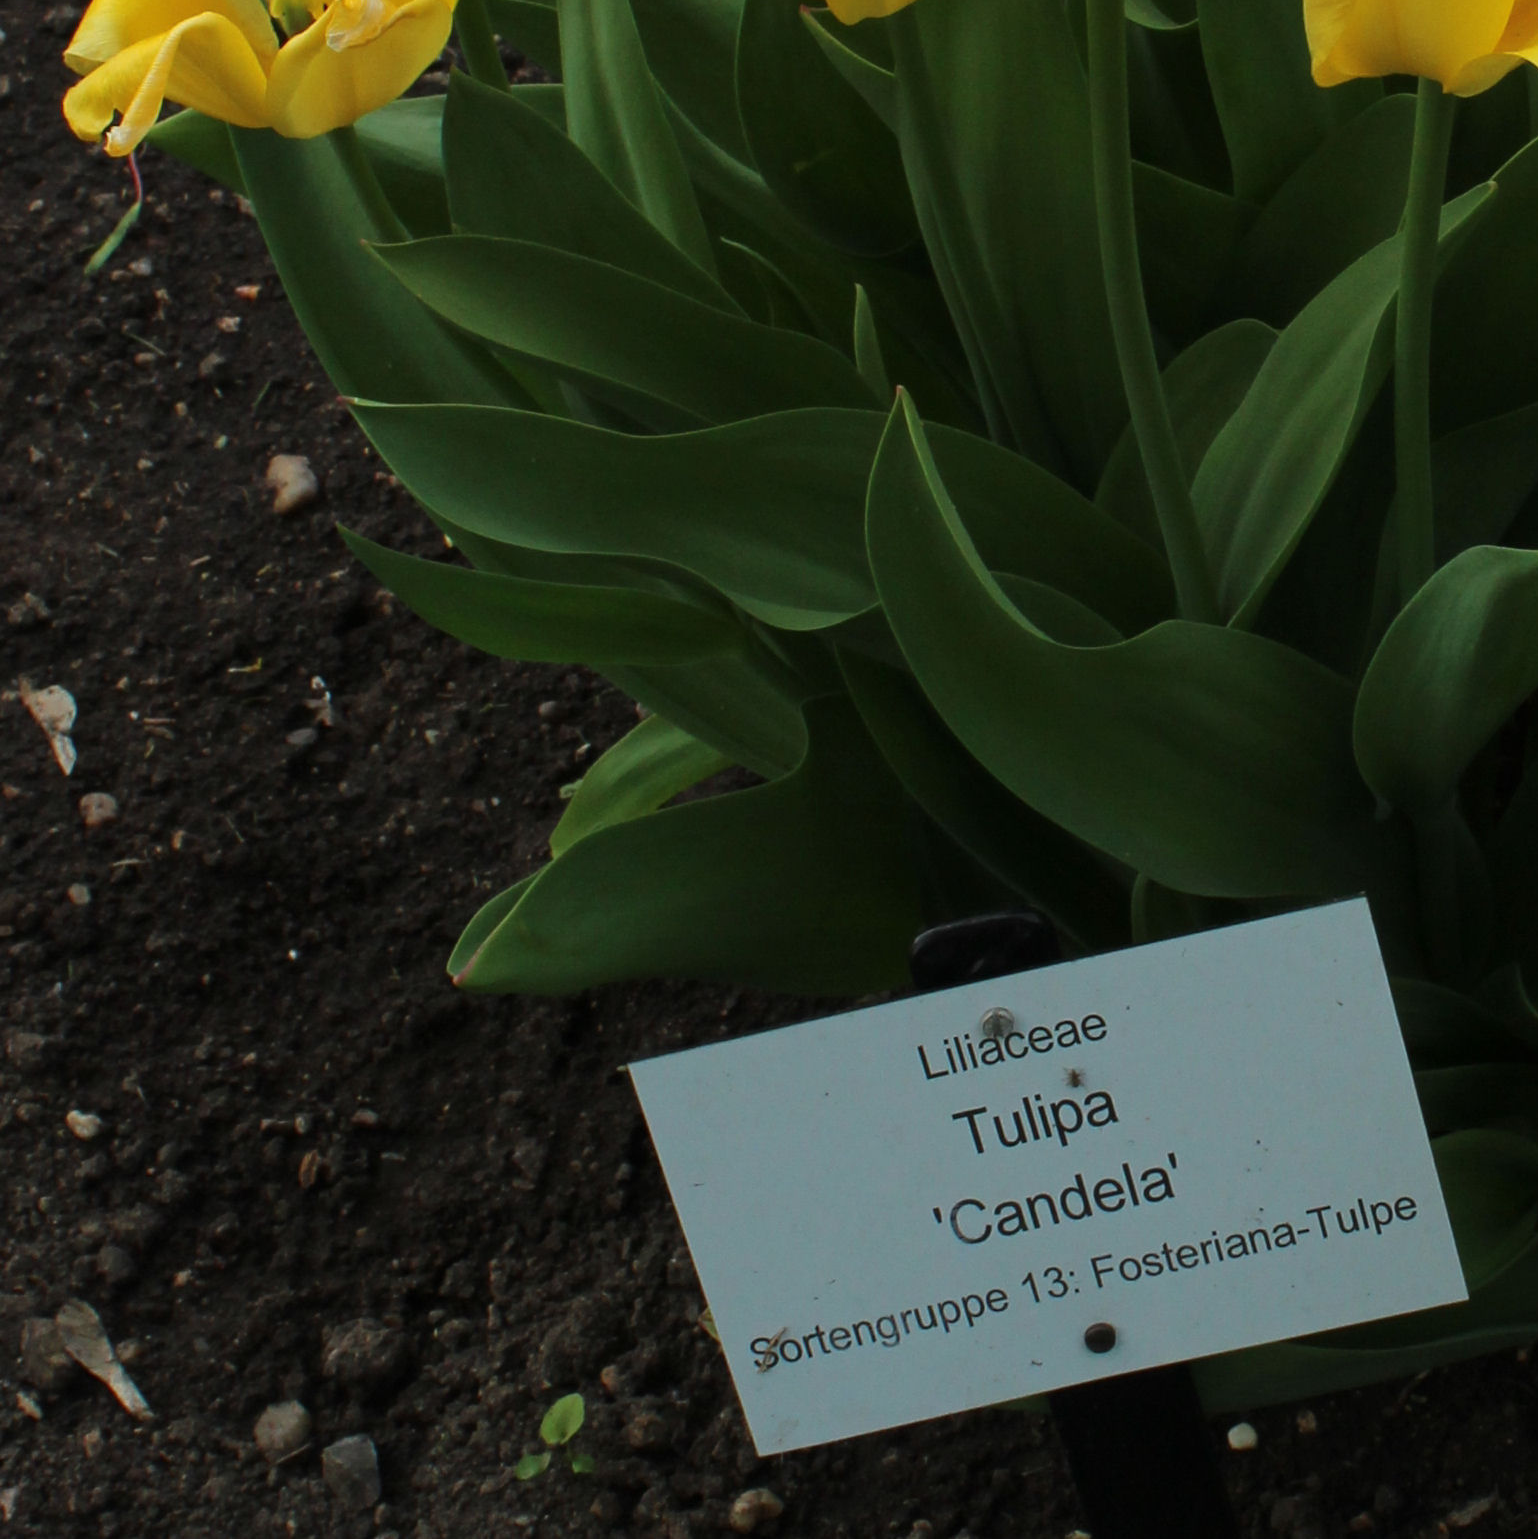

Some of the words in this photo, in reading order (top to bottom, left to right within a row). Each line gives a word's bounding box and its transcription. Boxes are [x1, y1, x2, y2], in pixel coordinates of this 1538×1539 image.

[917, 1013, 1108, 1081] Liliaceae
[951, 1090, 1120, 1155] Tulipa
[932, 1151, 1178, 1245] 'Candela'
[750, 1288, 1010, 1369] Sortengruppe
[1021, 1266, 1081, 1304] 13:
[1089, 1194, 1418, 1290] Fosteriana-Tulpe
